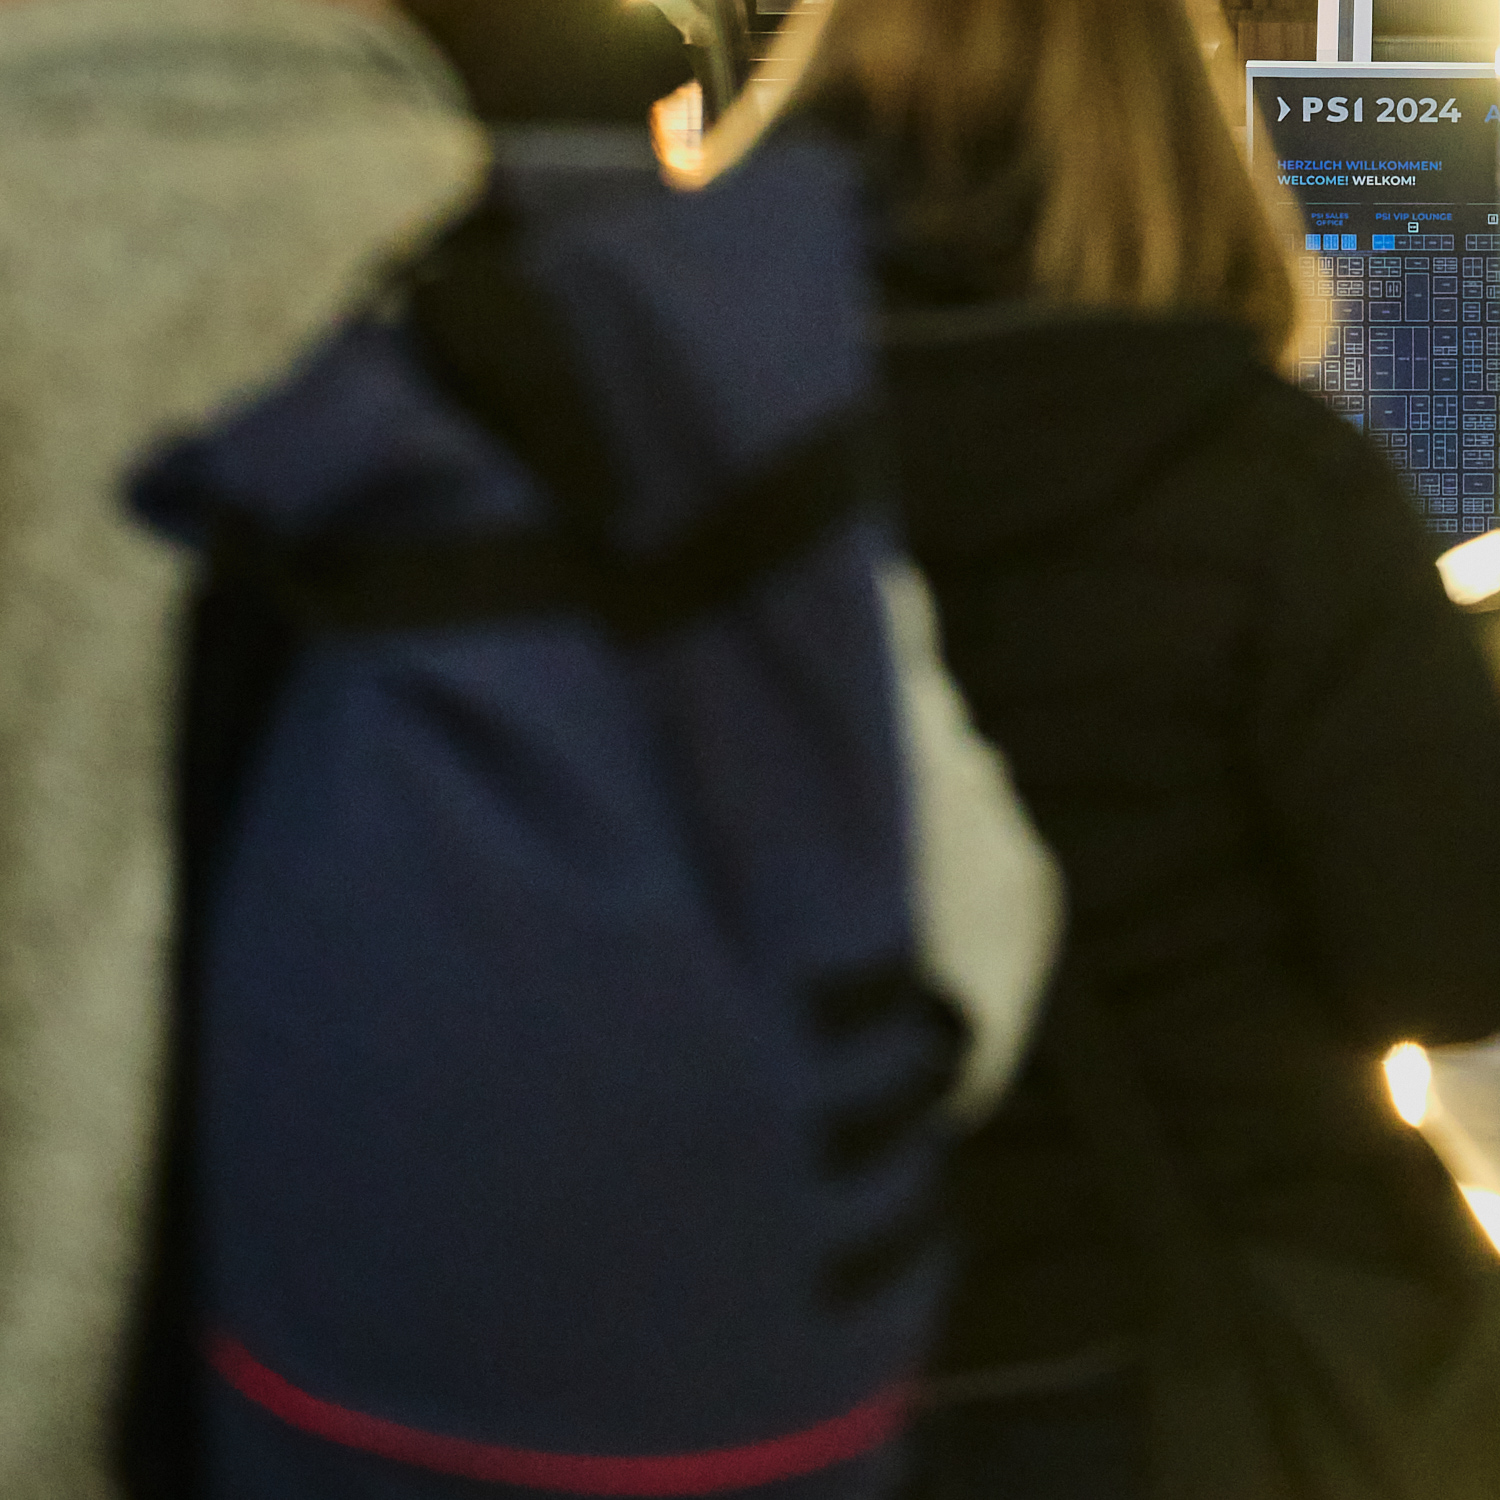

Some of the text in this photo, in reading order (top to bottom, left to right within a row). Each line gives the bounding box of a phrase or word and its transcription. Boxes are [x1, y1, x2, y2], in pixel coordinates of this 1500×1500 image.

[1302, 96, 1363, 123] PSI
[1375, 97, 1462, 123] 2024
[1277, 160, 1443, 171] HERZLICH WILLKOMMEN!
[1277, 175, 1417, 186] WELCOME! WELKOM!
[1325, 212, 1349, 220] SALES
[1375, 212, 1453, 221] PSI VIP LOUNGE
[1315, 219, 1344, 227] OFFICE
